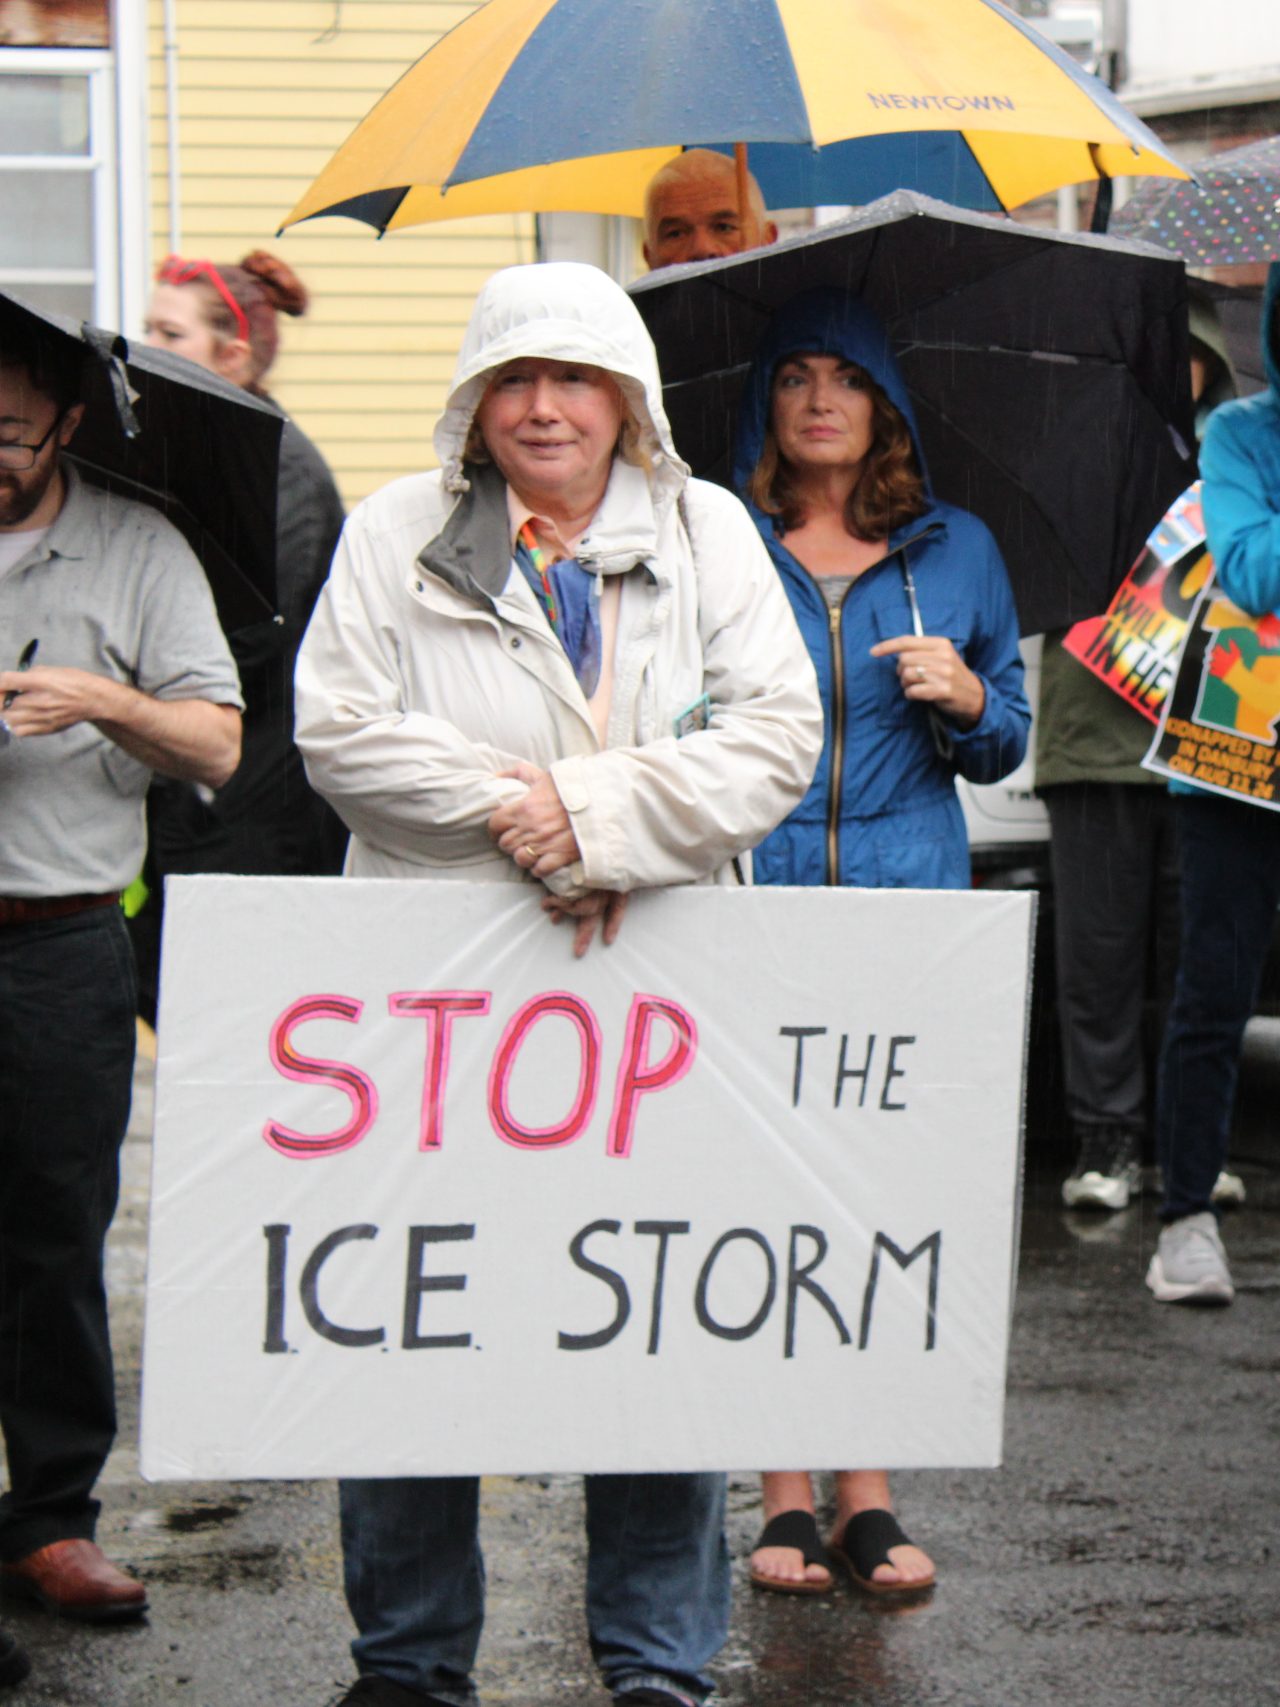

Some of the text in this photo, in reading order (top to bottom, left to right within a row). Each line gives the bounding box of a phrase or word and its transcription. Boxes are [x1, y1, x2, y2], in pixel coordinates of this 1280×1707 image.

[867, 92, 1015, 111] NEWTOWN
[1111, 587, 1167, 650] WILL
[1084, 620, 1133, 676] IN
[1168, 754, 1196, 775] ON
[1194, 763, 1230, 787] AUG
[1178, 739, 1275, 781] IN DANBURY
[1252, 743, 1276, 763] BY
[263, 991, 917, 1159] STOP THE
[558, 1219, 942, 1358] STORM
